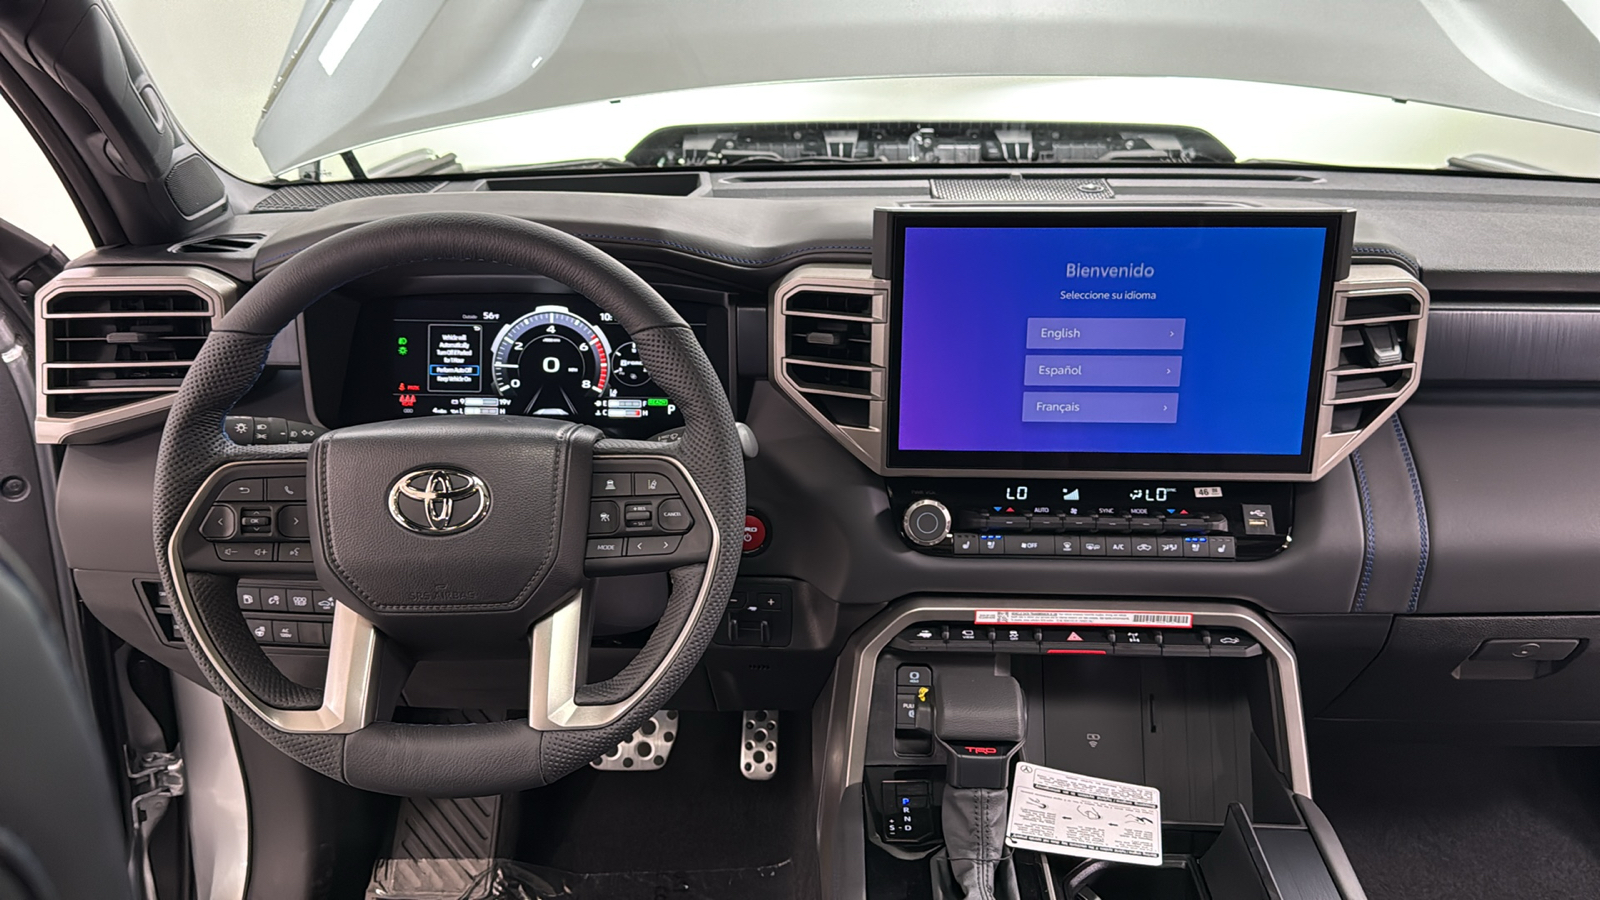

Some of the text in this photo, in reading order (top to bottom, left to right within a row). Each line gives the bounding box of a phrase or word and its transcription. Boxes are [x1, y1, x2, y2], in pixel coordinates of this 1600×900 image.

[1066, 262, 1155, 278] Bienvenido
[1060, 290, 1157, 300] Seleccione su idioma
[546, 325, 556, 334] 4
[1040, 328, 1081, 341] English
[513, 341, 524, 351] 2
[579, 342, 589, 352] 6
[542, 357, 560, 373] 0
[1038, 365, 1082, 377] Español
[510, 379, 521, 388] 0
[581, 380, 591, 389] 8
[667, 404, 676, 415] P
[1036, 402, 1080, 413] Français
[1006, 486, 1028, 500] LO
[1145, 487, 1168, 501] LO
[1199, 488, 1210, 496] 46
[964, 746, 997, 755] TRD
[902, 798, 910, 806] P
